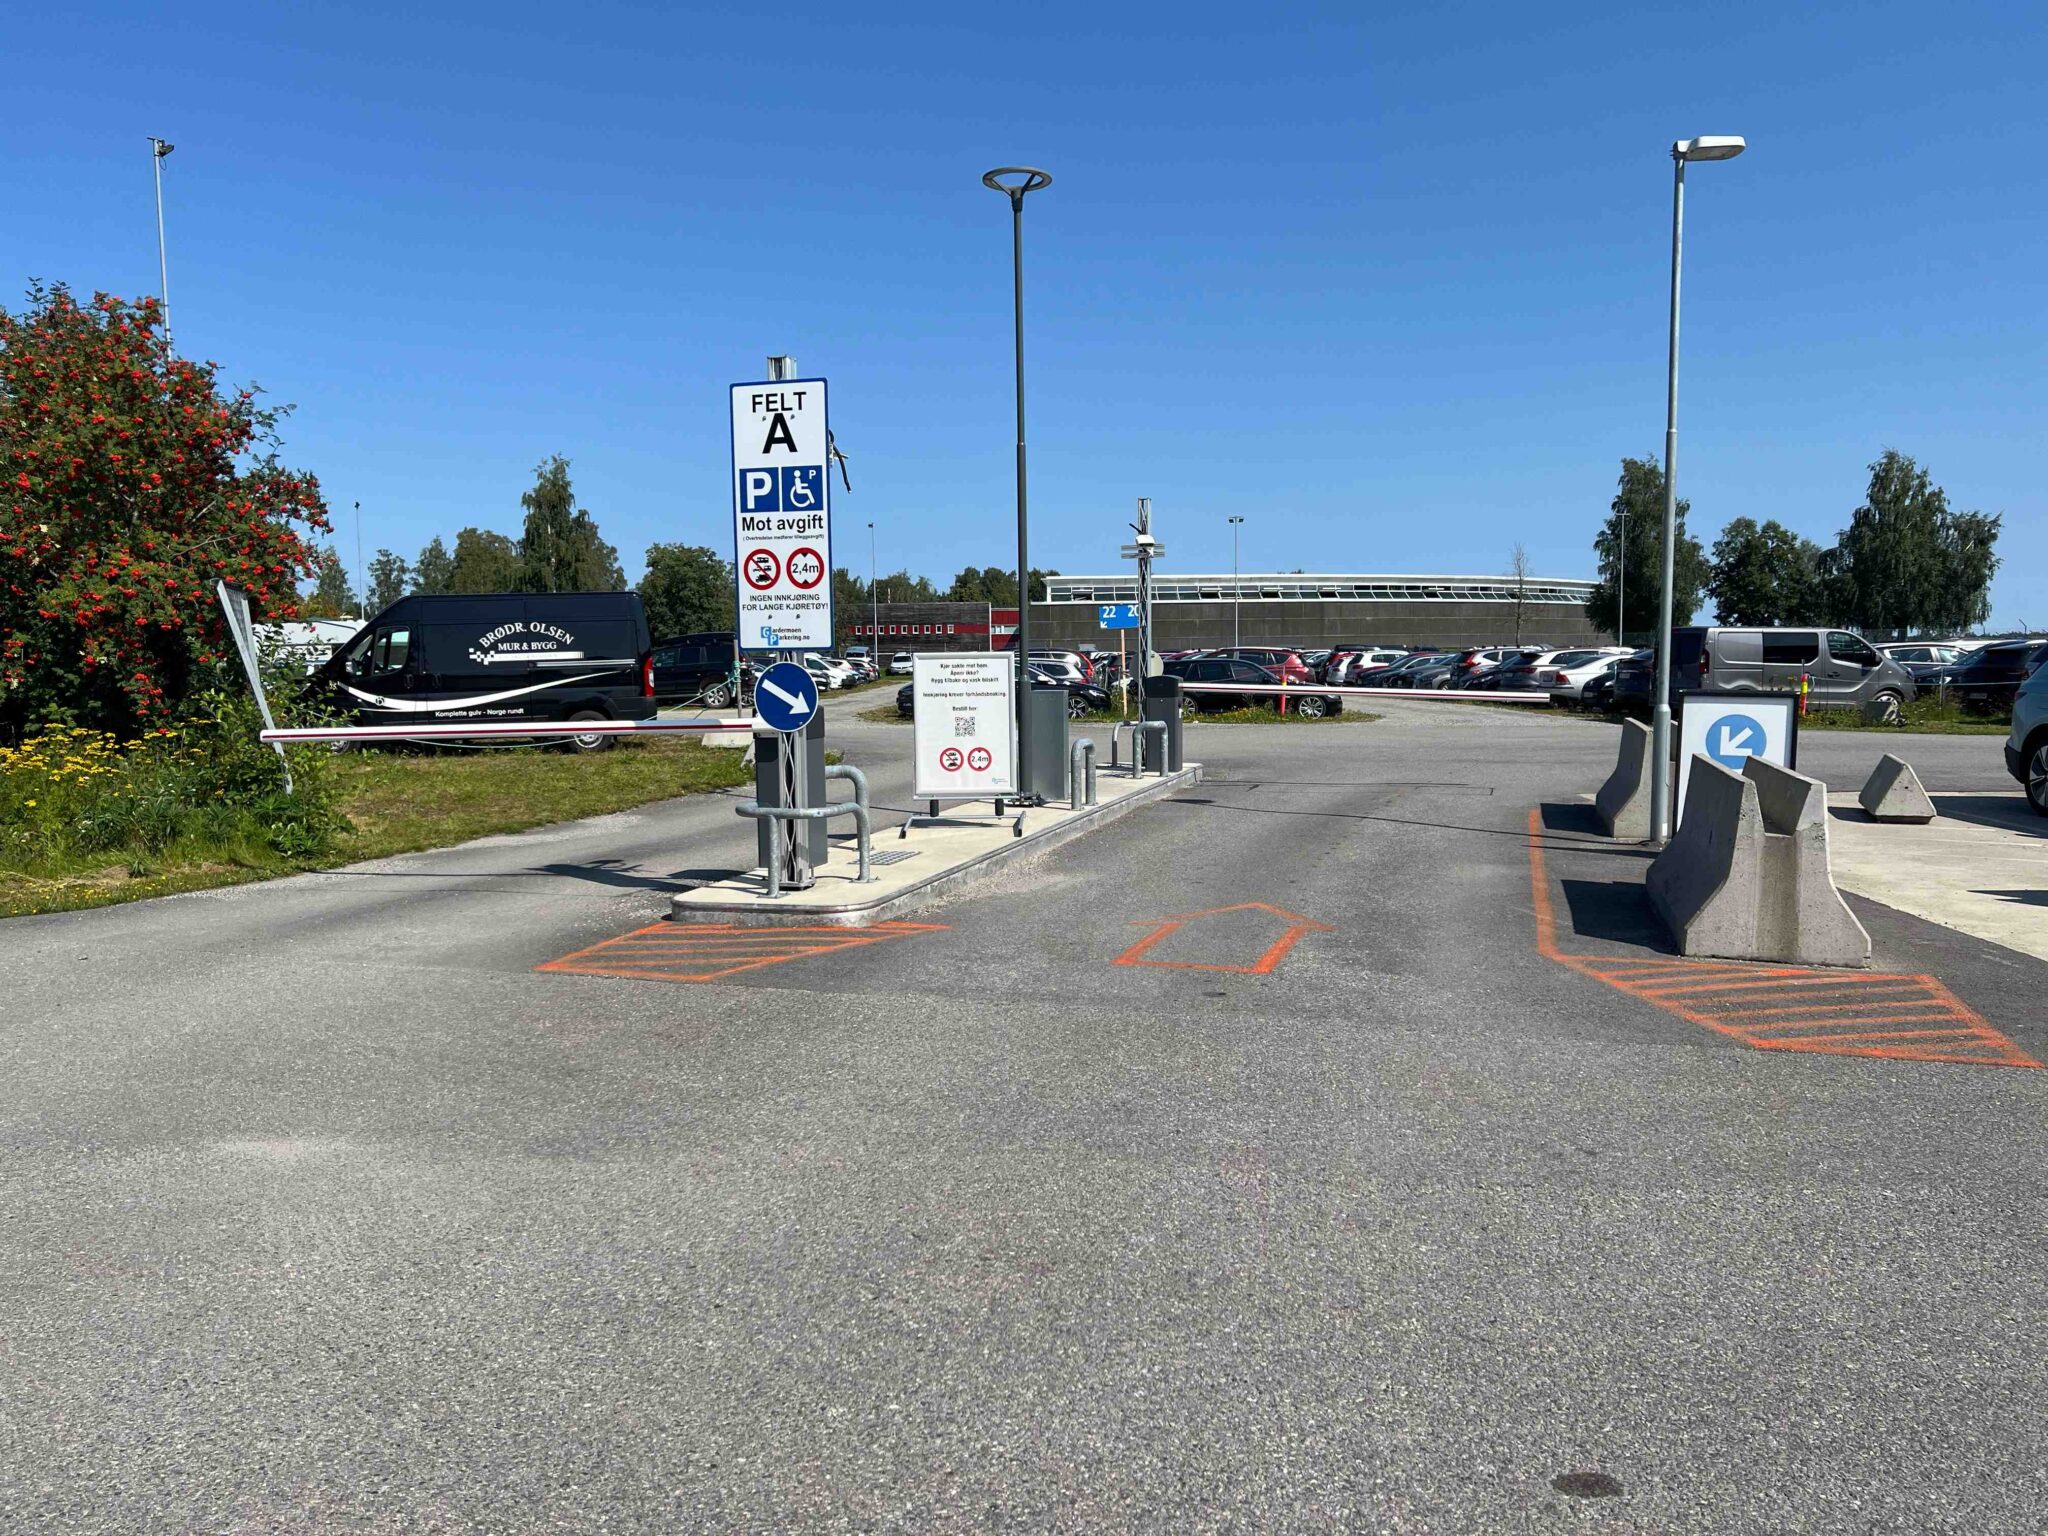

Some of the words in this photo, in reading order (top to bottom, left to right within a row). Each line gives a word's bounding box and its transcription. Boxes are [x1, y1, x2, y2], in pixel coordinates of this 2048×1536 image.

[752, 391, 807, 413] FELT
[762, 412, 798, 454] A
[809, 470, 816, 479] P
[746, 471, 772, 509] P
[742, 517, 772, 531] Mot
[777, 514, 823, 533] avgift
[792, 563, 819, 575] 2,4m
[1102, 605, 1116, 618] 22
[479, 622, 527, 647] BRØDR.
[530, 621, 575, 645] OLSEN
[498, 643, 520, 651] MUR
[521, 642, 529, 650] &
[531, 641, 557, 650] BYGG
